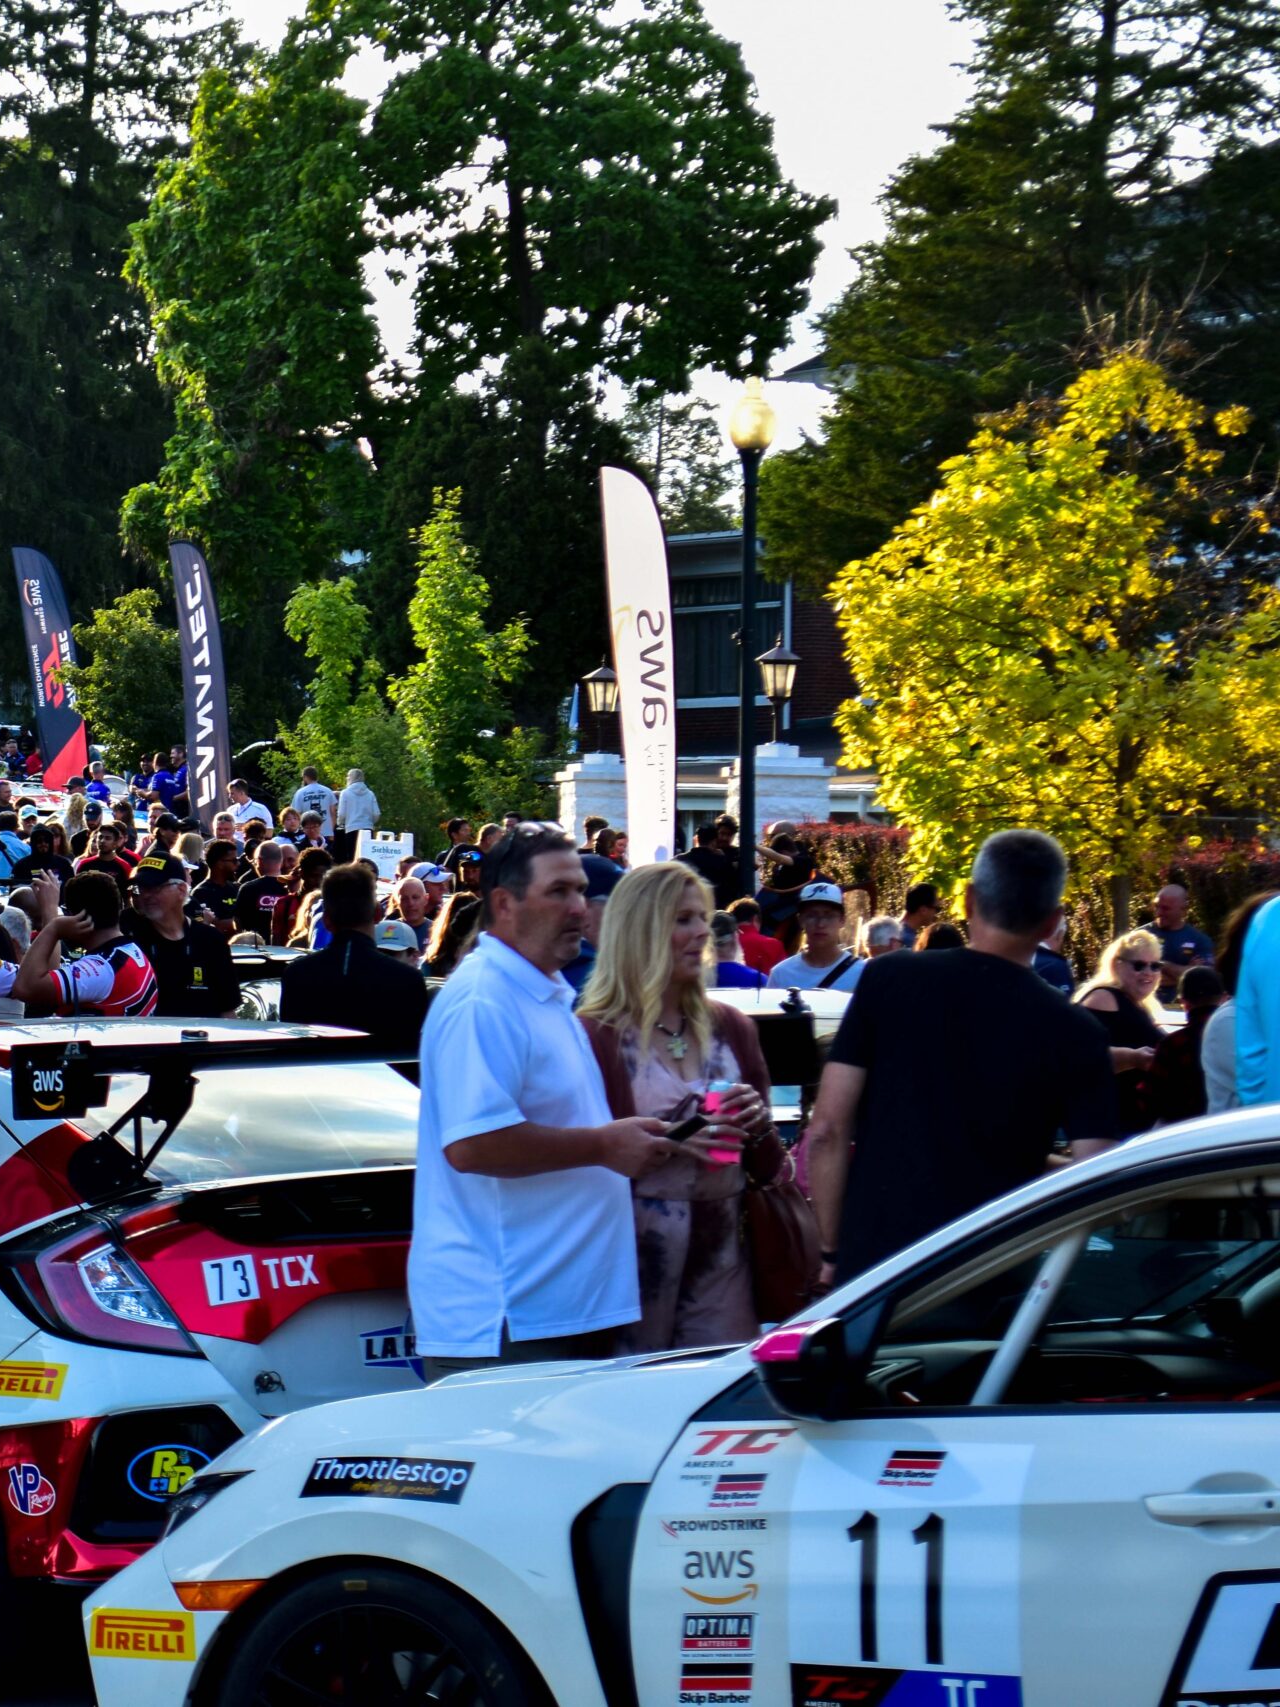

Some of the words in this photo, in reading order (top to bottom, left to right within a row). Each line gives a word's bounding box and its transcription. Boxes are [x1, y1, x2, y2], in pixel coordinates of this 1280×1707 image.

[33, 1070, 64, 1092] aws
[210, 1260, 251, 1302] 73
[262, 1254, 320, 1290] TCX
[692, 1427, 800, 1456] TC
[683, 1460, 734, 1468] AMERICA
[881, 1469, 903, 1479] Skip
[903, 1470, 937, 1479] Barber
[313, 1458, 468, 1491] Throttlestop
[877, 1479, 904, 1487] Racing
[9, 1464, 41, 1514] VP
[711, 1492, 730, 1500] Skip
[730, 1492, 761, 1500] Barber
[670, 1518, 768, 1532] CROWDSTRIKE
[684, 1549, 756, 1580] aws
[847, 1510, 944, 1666] 11
[95, 1614, 186, 1654] PIRELLI
[686, 1618, 750, 1636] OPTIMA
[697, 1640, 739, 1648] BATTERIES
[678, 1692, 706, 1706] Skip
[707, 1692, 751, 1704] Barber
